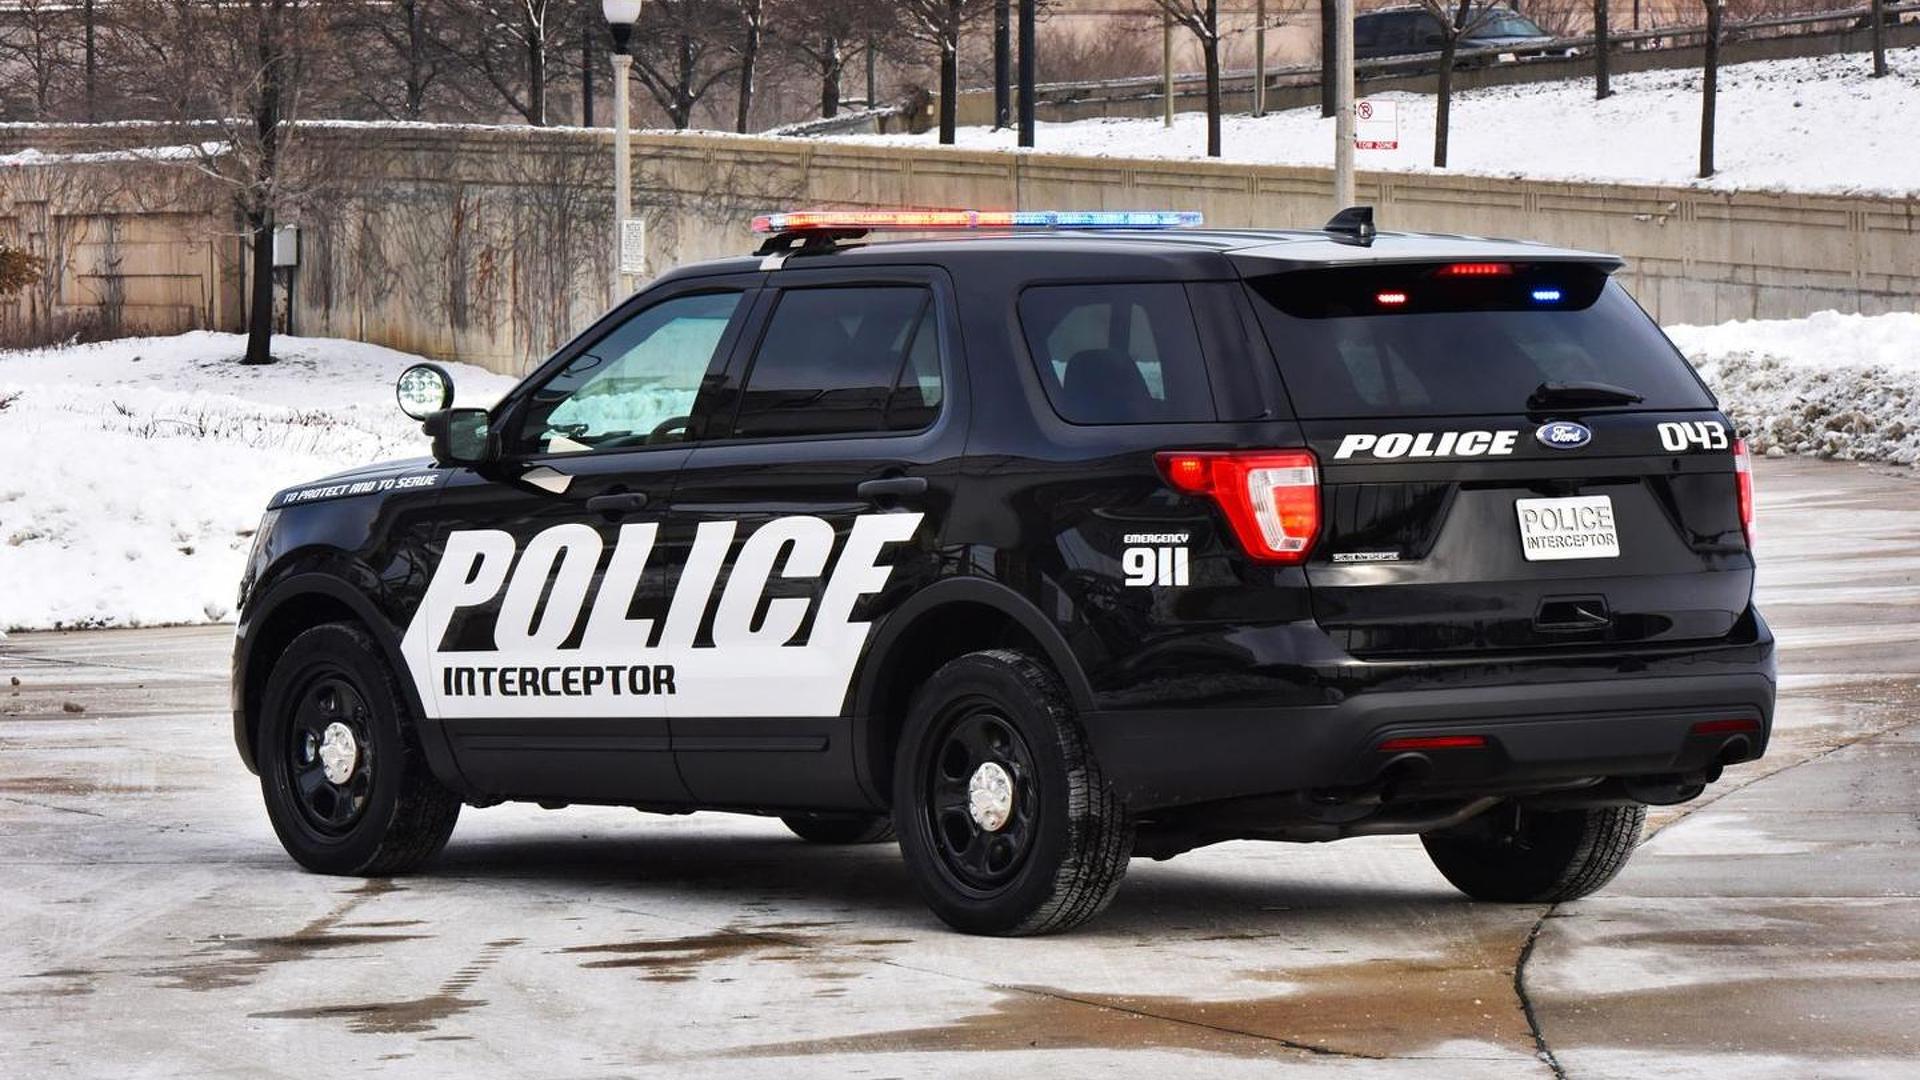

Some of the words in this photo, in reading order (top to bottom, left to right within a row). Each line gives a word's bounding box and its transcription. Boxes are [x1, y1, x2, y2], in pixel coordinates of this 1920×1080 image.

[1334, 430, 1518, 459] POLICE
[1657, 422, 1729, 452] 043
[284, 493, 297, 503] TO
[297, 484, 350, 500] PROTECT
[349, 480, 377, 493] AND
[378, 477, 395, 490] TO
[395, 474, 439, 489] SERVE
[1522, 506, 1613, 533] POLICE
[1123, 533, 1189, 543] EMERGENCY
[1527, 533, 1615, 549] INTERCEPTOR
[1122, 547, 1189, 587] 911
[405, 512, 924, 652] POLICE
[443, 665, 677, 696] INTERCEPTOR
